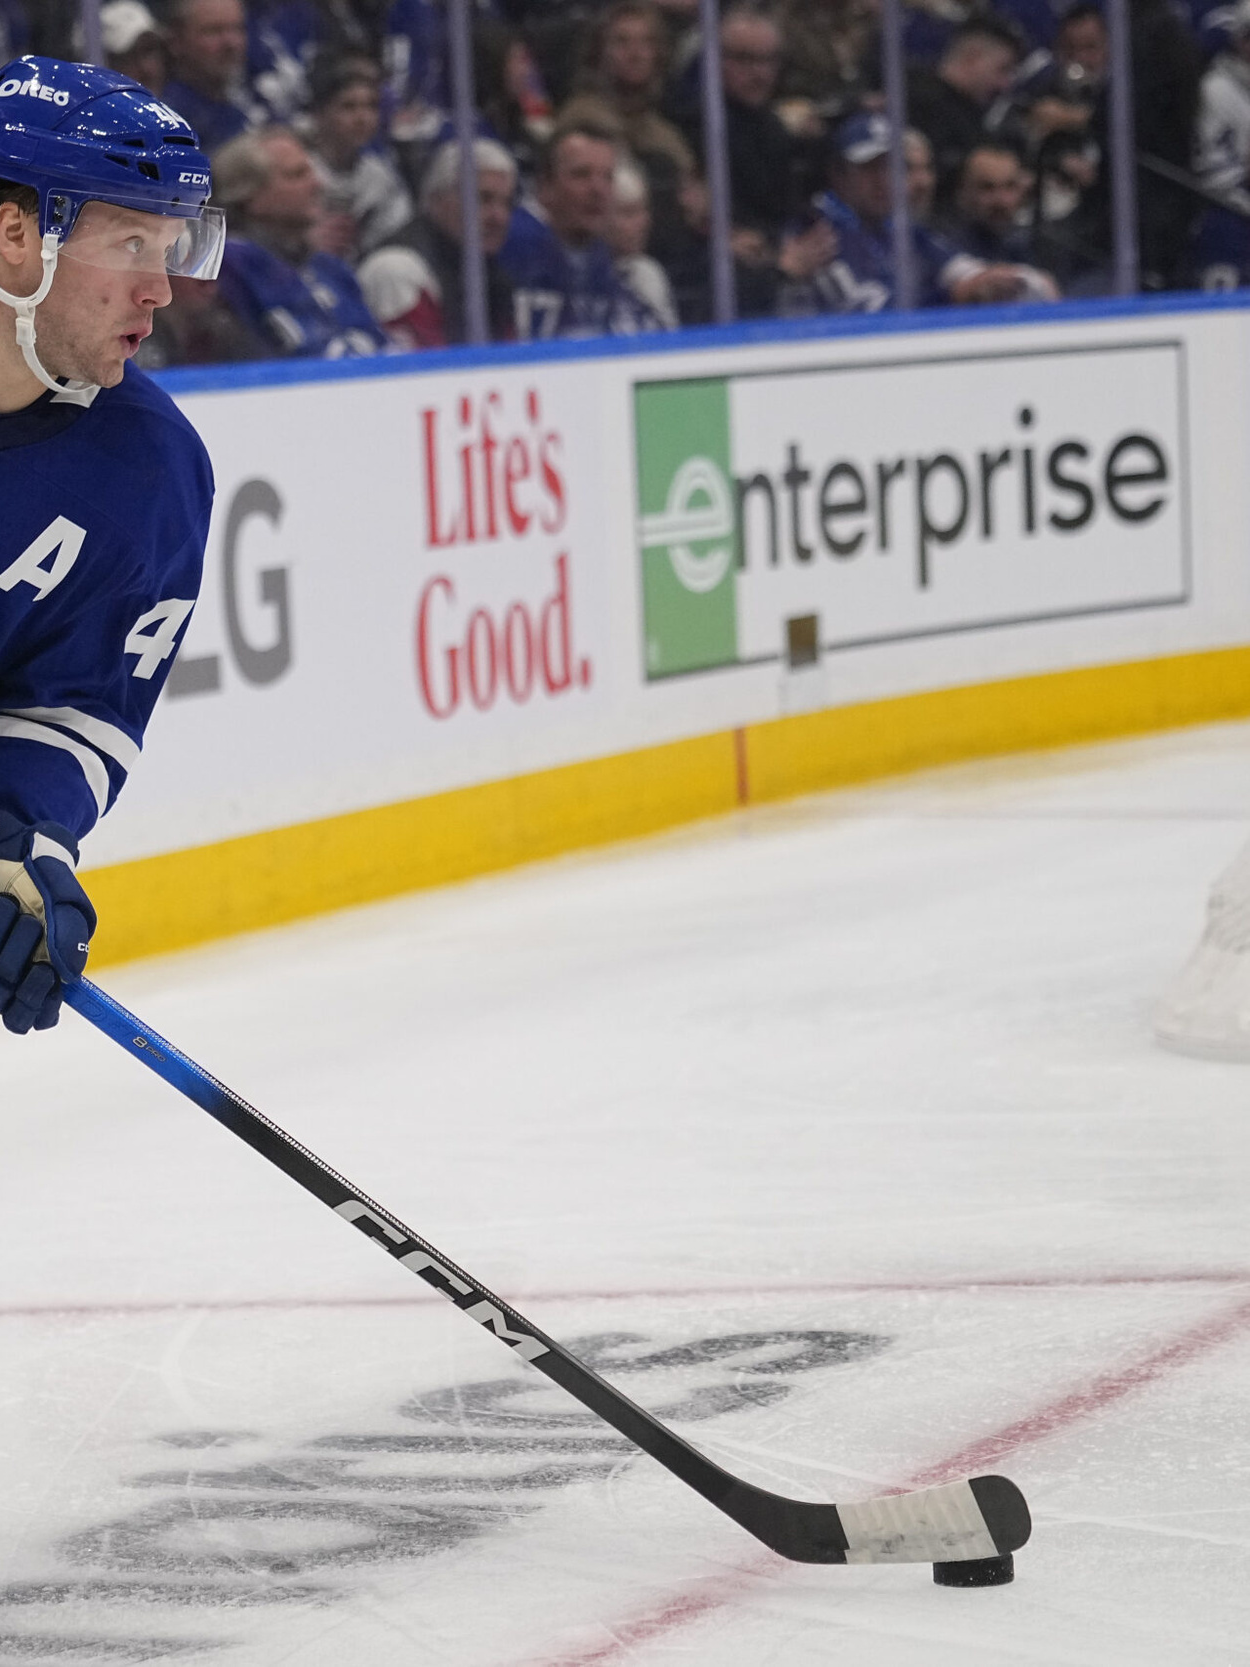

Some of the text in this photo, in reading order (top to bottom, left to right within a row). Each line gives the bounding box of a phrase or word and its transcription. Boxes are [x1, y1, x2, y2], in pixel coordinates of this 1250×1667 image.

[178, 172, 210, 185] CCM
[419, 387, 567, 550] Life's
[639, 403, 1169, 593] enterprise
[414, 551, 592, 722] Good.
[332, 1199, 551, 1362] CCM
